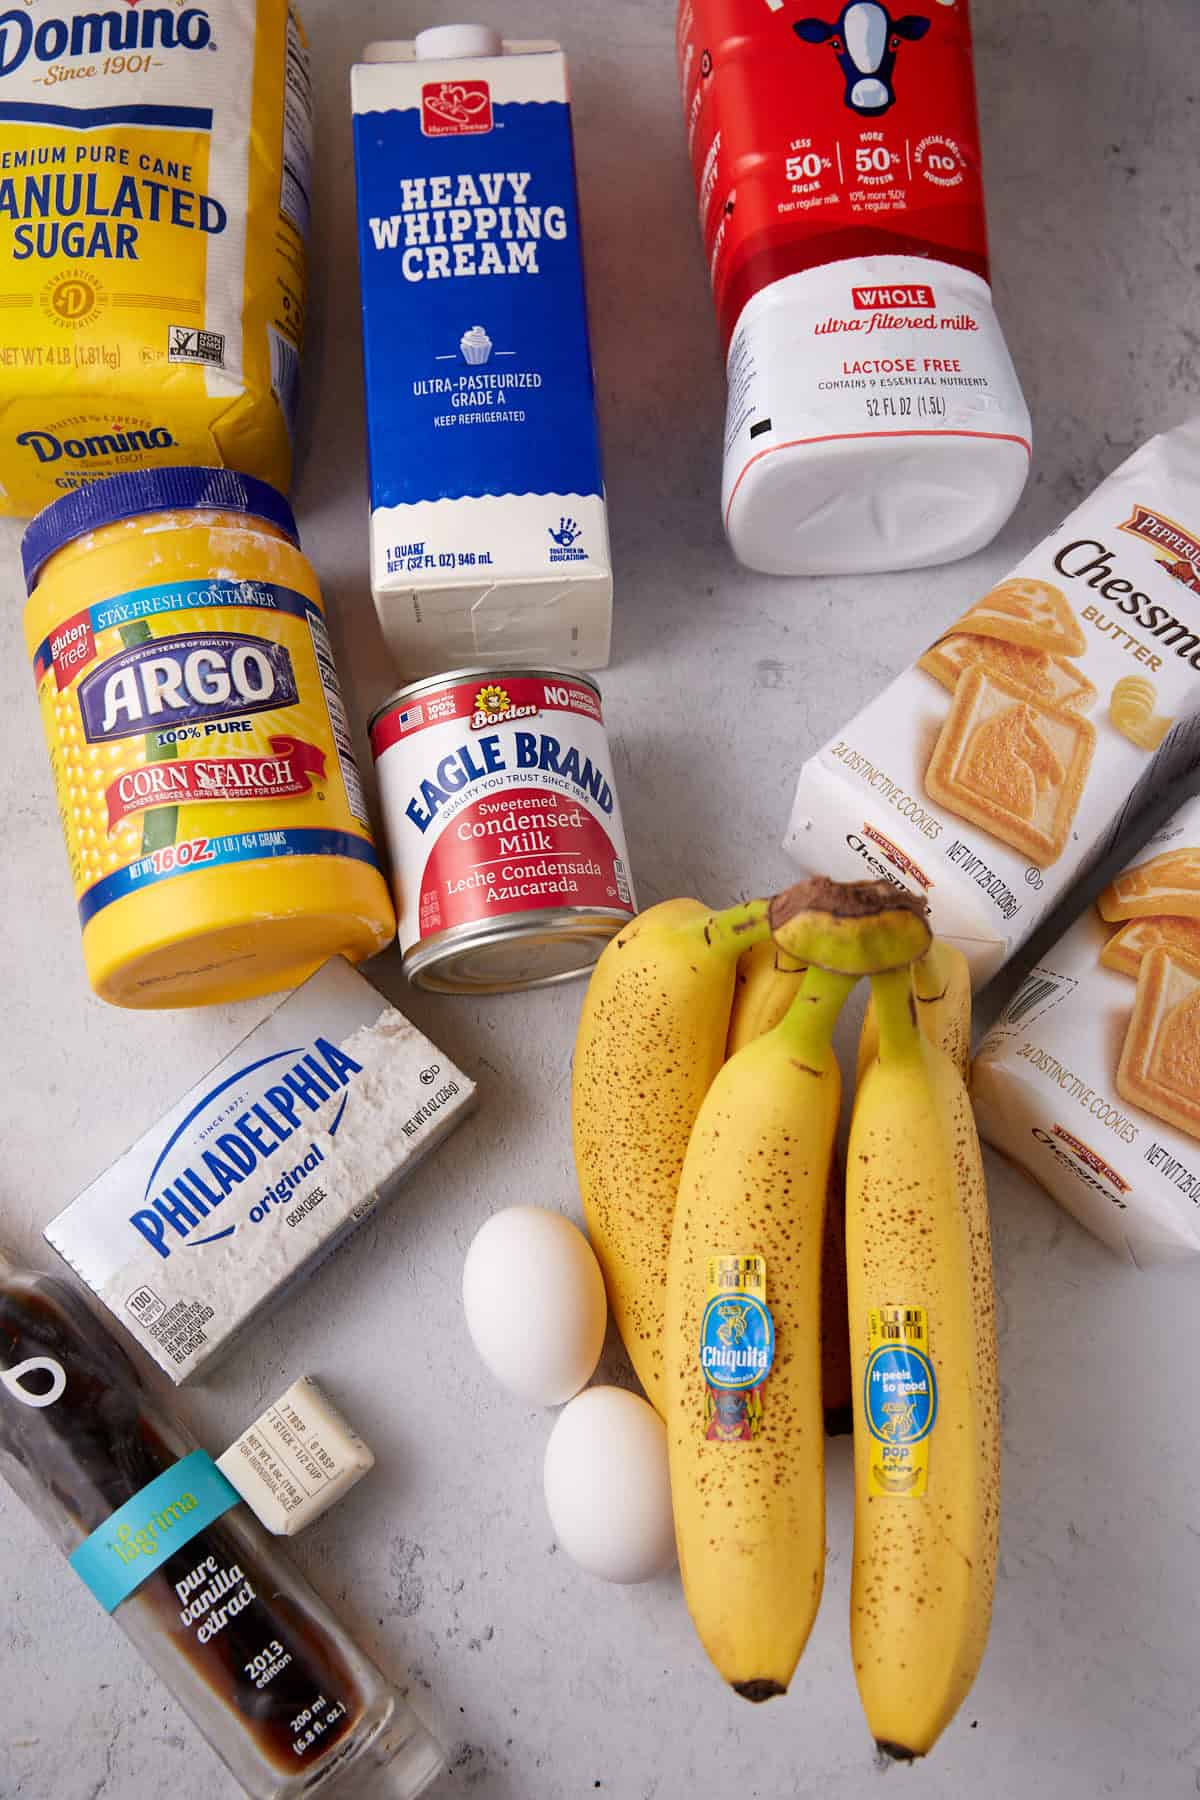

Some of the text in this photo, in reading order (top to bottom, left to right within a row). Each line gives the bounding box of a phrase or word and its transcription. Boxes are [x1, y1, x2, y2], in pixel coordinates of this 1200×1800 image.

[0, 8, 211, 78] Domino
[44, 55, 151, 86] Since 1901
[790, 138, 812, 151] LESS
[859, 131, 885, 142] MORE
[76, 146, 129, 166] PURE
[139, 154, 192, 182] CANE
[928, 155, 955, 170] no
[400, 172, 531, 212] HEAVY
[791, 181, 821, 193] SUGAR
[857, 173, 894, 185] PROTEIN
[778, 203, 796, 213] than
[796, 197, 823, 210] regular
[12, 222, 138, 260] SUGAR
[369, 206, 568, 250] WHIPPING
[402, 242, 540, 282] CREAM
[856, 289, 929, 307] WHOLE
[814, 313, 979, 335] ultra-filtered milk
[23, 348, 44, 366] WT
[46, 347, 55, 366] 4
[57, 347, 72, 366] LB
[843, 358, 961, 375] LACTOSE FREE
[413, 373, 542, 396] ULTRA-PASTEURIZED
[818, 376, 989, 391] CONTAINS ESSENTIAL NUTRIENTS
[451, 390, 506, 408] GRADE A
[866, 398, 880, 418] 52
[882, 397, 897, 417] FL
[433, 410, 526, 428] KEEP REFRIGERATED
[16, 427, 174, 463] Domino
[387, 551, 493, 573] NET (32 FL OZ) 946 mL
[394, 542, 425, 558] QUART
[97, 589, 277, 630] STAY-FRESH CONTAINER
[51, 622, 91, 660] gluten-
[1081, 604, 1163, 673] BUTTER
[102, 646, 276, 733] ARGO
[543, 686, 569, 707] NO
[471, 704, 538, 729] Borden
[156, 720, 253, 748] 100% PURE
[119, 759, 293, 802] CORN STARCH
[404, 731, 615, 834] EAGLE BRAND
[831, 741, 944, 841] 24 DISTINCTIVE COOKIES
[442, 773, 570, 818] QUALITY YOU TRUST SINCE
[478, 795, 558, 816] Sweetened
[457, 809, 583, 841] Condensed
[152, 848, 175, 873] 16
[176, 839, 214, 865] OZ.
[241, 835, 258, 849] 454
[258, 831, 287, 848] GRAMS
[499, 830, 553, 856] Milk
[446, 869, 496, 896] Leche
[501, 858, 602, 881] Condensada
[945, 840, 971, 864] NET
[961, 853, 984, 876] WT
[986, 878, 1007, 900] OZ
[485, 877, 580, 904] Azucarada
[426, 1097, 441, 1113] OZ
[1030, 1048, 1097, 1107] DISTINCTIVE
[1089, 1097, 1140, 1144] COOKIES
[412, 1110, 428, 1126] WT
[421, 1106, 432, 1117] 8
[199, 1115, 225, 1140] SINCE
[401, 1119, 419, 1137] NET
[129, 1037, 364, 1259] PHILADELPHIA
[1143, 1143, 1170, 1168] NET
[1160, 1156, 1183, 1180] WT
[249, 1143, 325, 1223] original
[285, 1204, 308, 1228] CREAM
[302, 1186, 328, 1211] CHEESE
[130, 1290, 152, 1312] 100
[701, 1344, 770, 1372] Chiquita
[882, 1379, 927, 1396] so good
[287, 1410, 307, 1434] TBSP
[246, 1433, 262, 1451] NET
[272, 1419, 296, 1446] STICK
[304, 1462, 324, 1481] CUP
[882, 1446, 910, 1462] pop
[315, 1446, 336, 1470] TBSP
[175, 1555, 219, 1606] pure
[178, 1564, 245, 1628] vanilla
[196, 1581, 257, 1644] extract
[243, 1639, 285, 1681] 2013
[255, 1652, 293, 1690] edition
[289, 1695, 327, 1733] 200 ml
[292, 1730, 316, 1756] (6.8
[326, 1701, 348, 1725] oz.)
